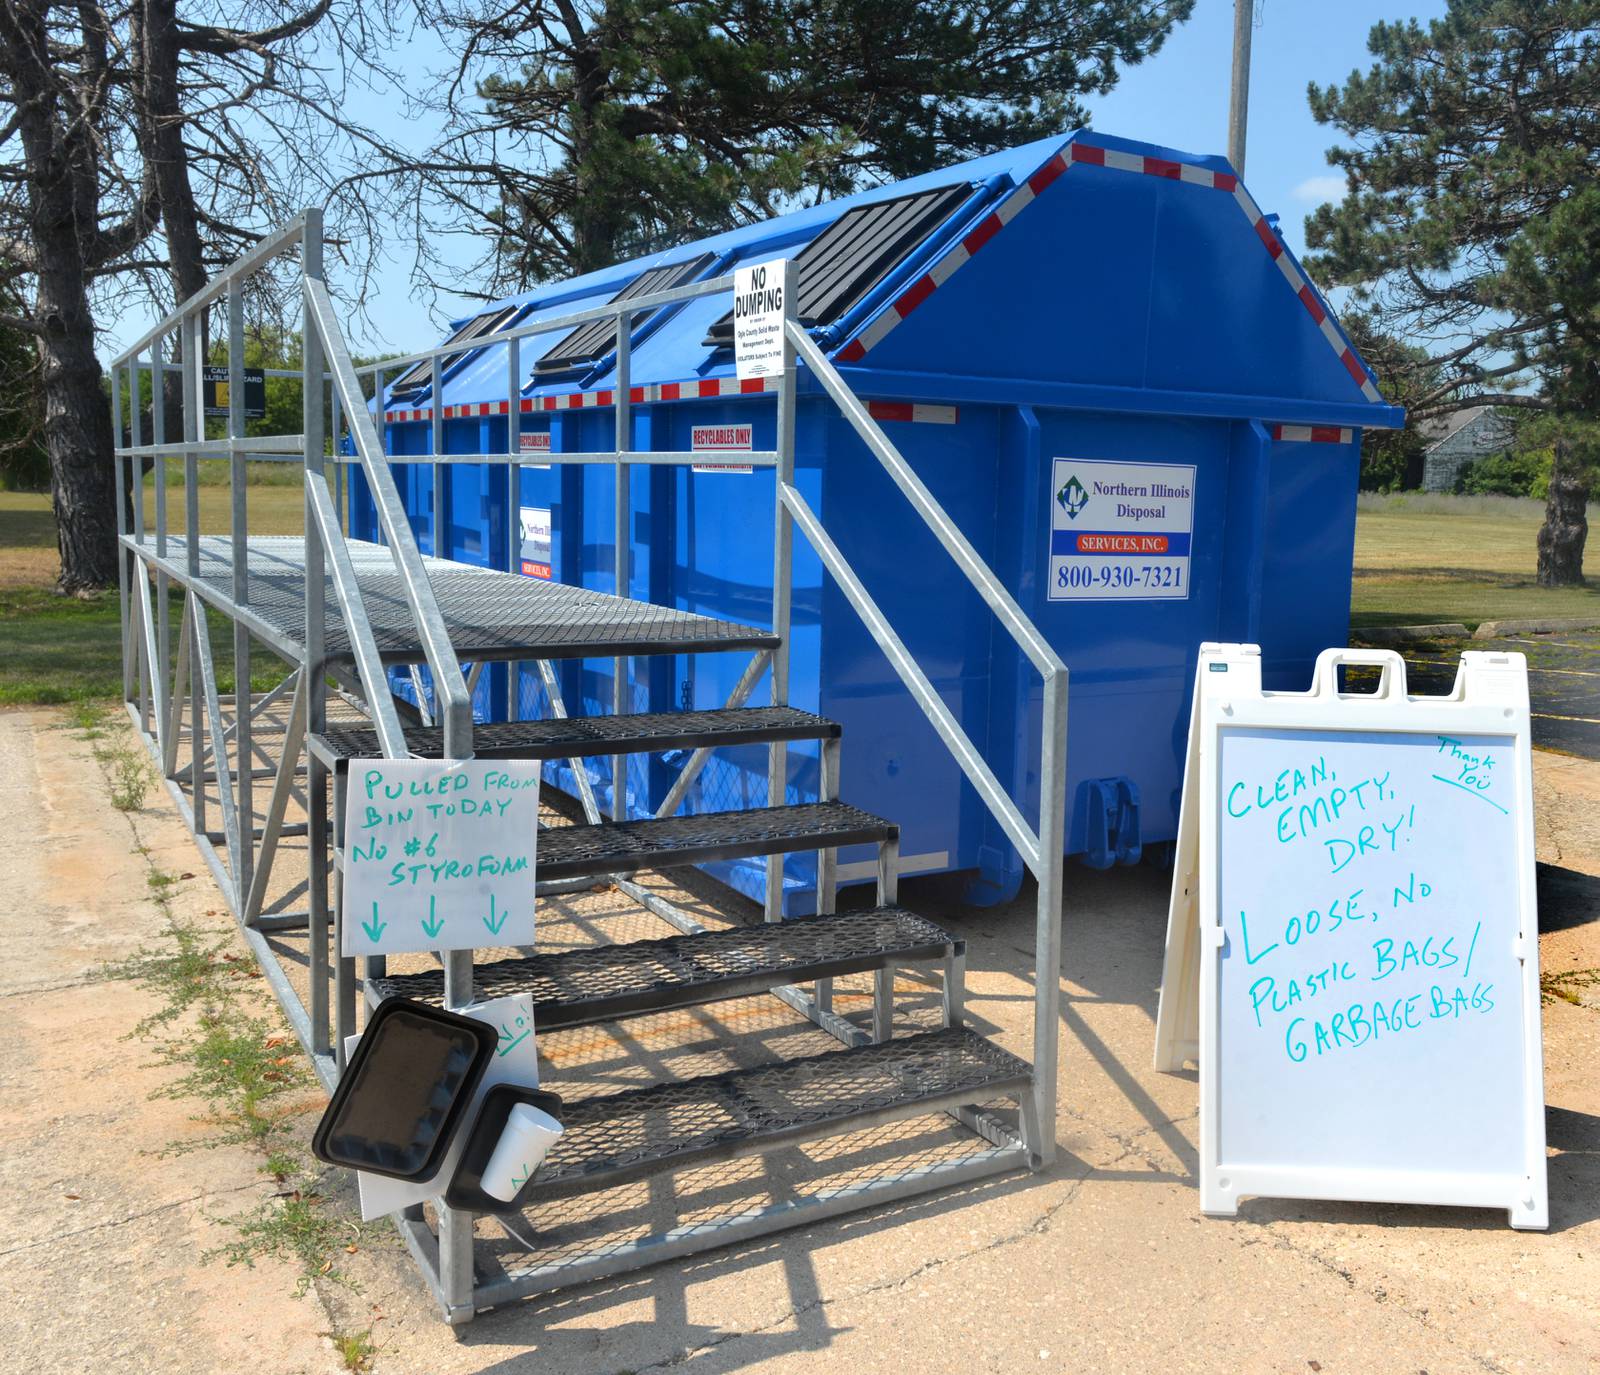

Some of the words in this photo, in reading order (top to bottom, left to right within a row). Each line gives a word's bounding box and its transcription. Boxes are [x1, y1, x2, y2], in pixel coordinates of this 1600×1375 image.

[751, 266, 766, 291] NO
[736, 287, 782, 318] DUMPING
[758, 326, 767, 334] Solid
[743, 340, 764, 348] Management
[694, 429, 734, 444] RECYCLABLES
[736, 429, 751, 444] ONLY
[1093, 481, 1147, 497] Northern
[1151, 484, 1190, 498] Illinois
[1117, 504, 1165, 521] Disposal
[527, 523, 544, 535] Northern
[1082, 537, 1139, 551] SERVICES,
[1142, 538, 1164, 550] INC.
[1058, 566, 1181, 588] 800-930-7321
[1437, 735, 1496, 770] Thank
[364, 770, 469, 800] PULLED
[484, 771, 538, 791] FROM
[1227, 756, 1335, 818] CLEAN,
[361, 806, 413, 829] BIN
[426, 798, 513, 819] TODAY
[1277, 772, 1394, 843] EMPTY,
[403, 833, 438, 857] #6
[1324, 804, 1415, 873] DRY!
[1240, 889, 1378, 965] LOOSE,
[1249, 962, 1356, 1027] PLASTIC
[1286, 994, 1422, 1062] GARBAGE
[1430, 983, 1495, 1018] BAGS
